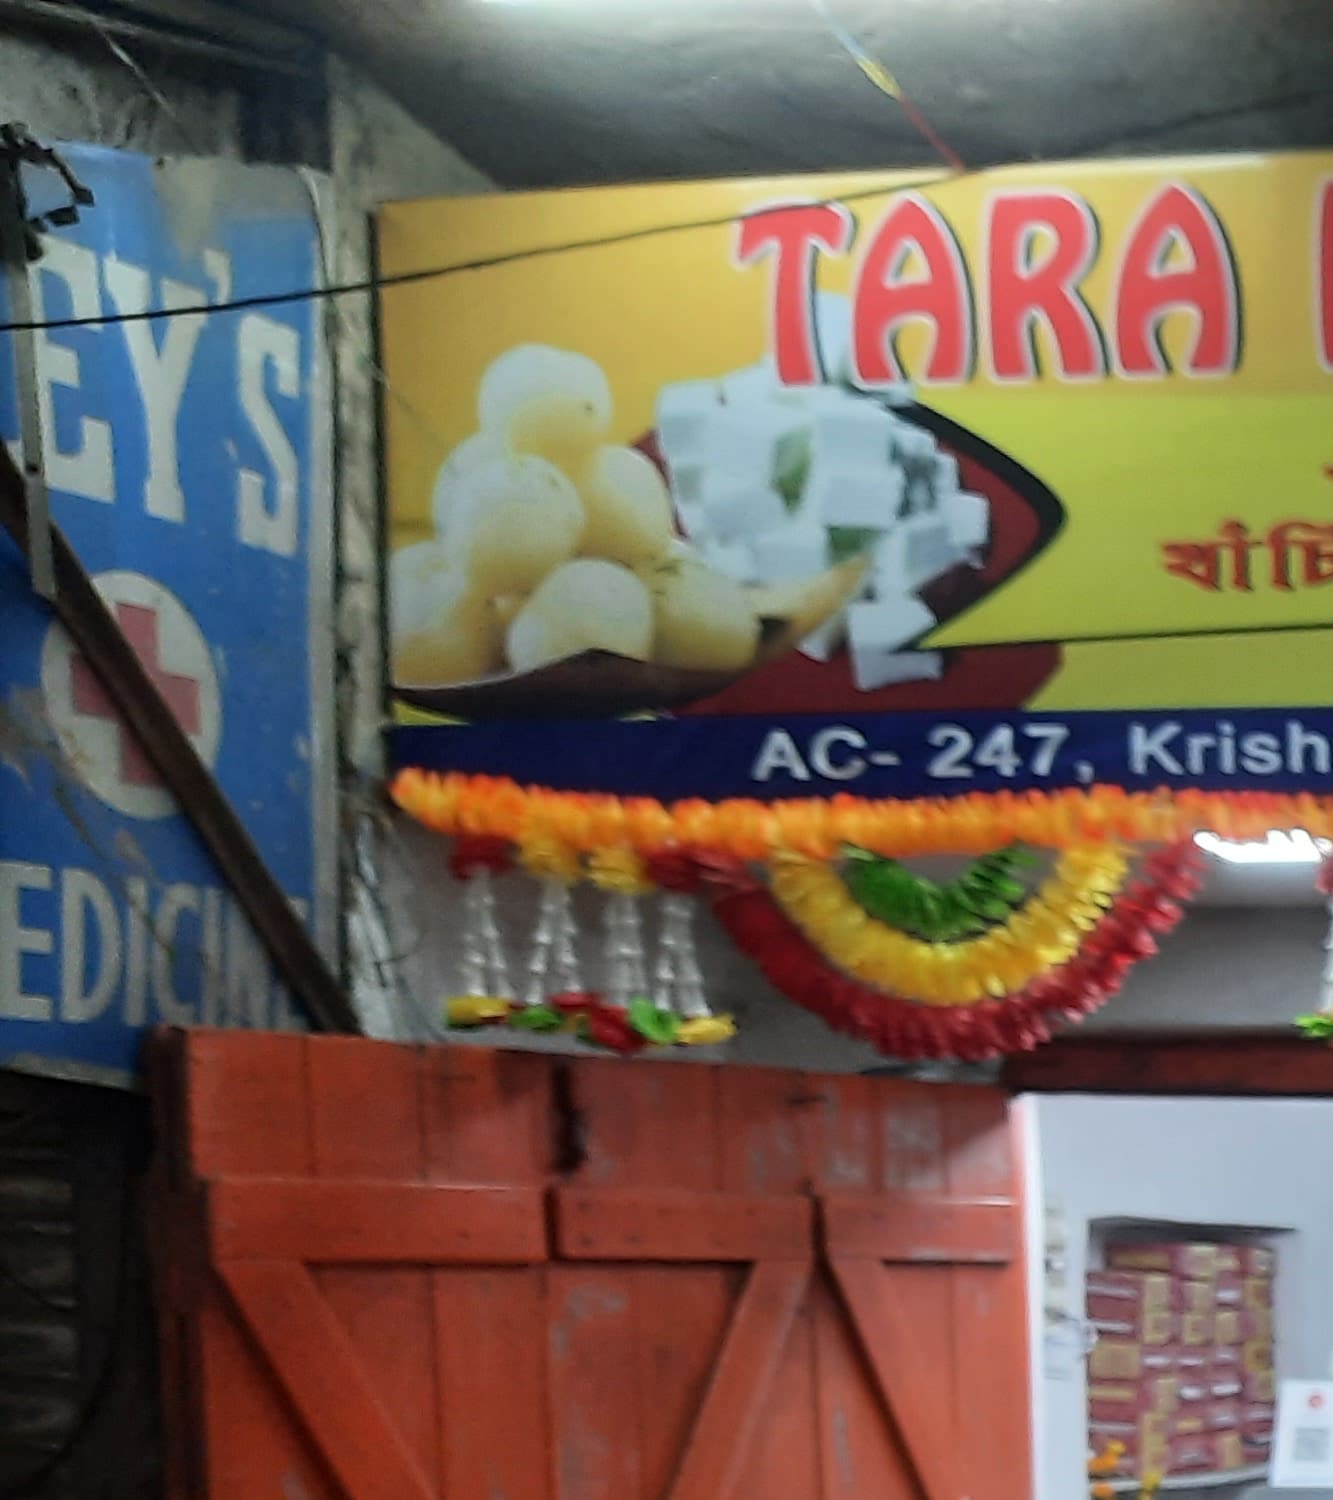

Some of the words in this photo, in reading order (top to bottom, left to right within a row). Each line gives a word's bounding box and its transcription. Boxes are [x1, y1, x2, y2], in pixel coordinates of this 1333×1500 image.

[736, 183, 1242, 386] TARA
[751, 728, 902, 781] AC-
[927, 724, 1093, 784] 247,
[0, 861, 308, 1032] EDICIN
